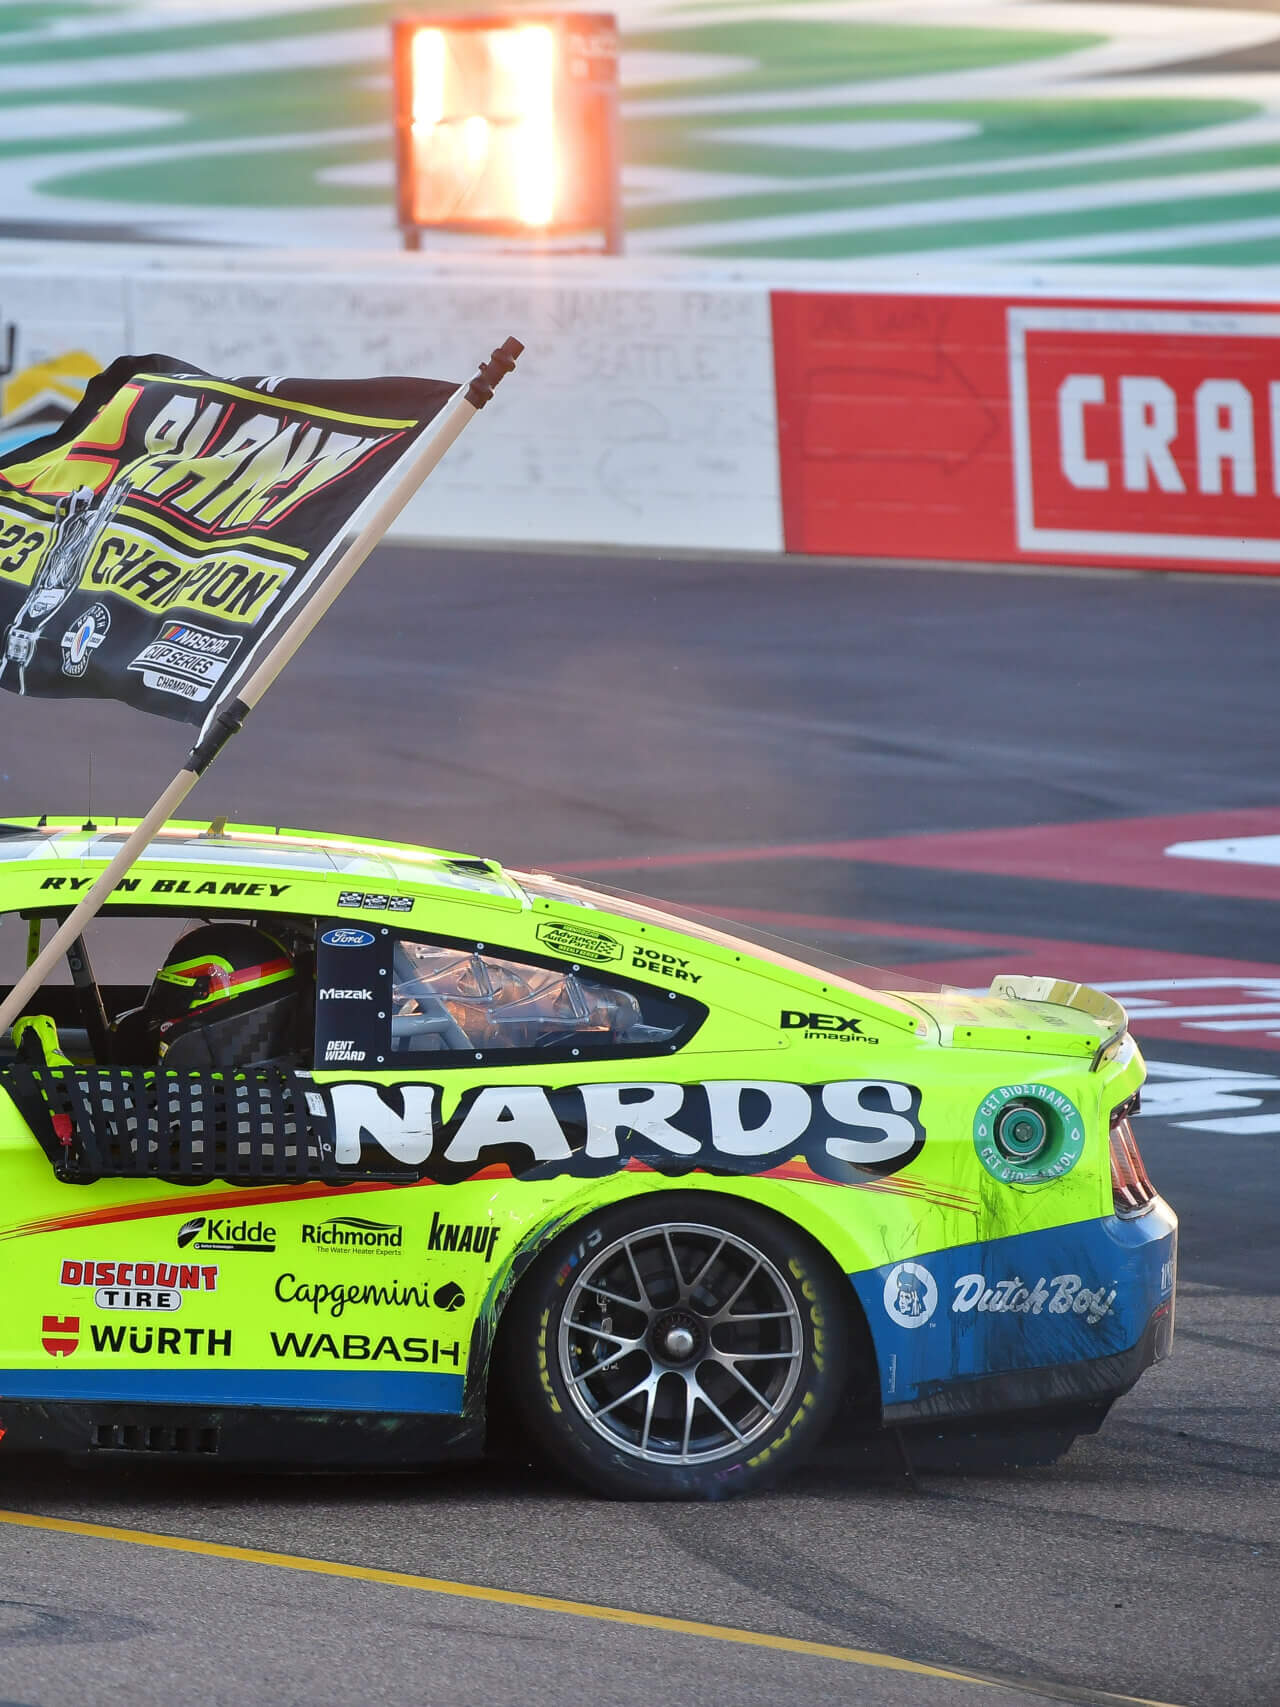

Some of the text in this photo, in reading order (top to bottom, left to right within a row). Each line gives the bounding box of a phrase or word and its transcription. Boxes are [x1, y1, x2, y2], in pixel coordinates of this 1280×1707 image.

[1058, 374, 1280, 498] CRA
[175, 629, 230, 654] NASCAR
[144, 645, 214, 674] CUP SERIES
[156, 675, 199, 697] CHAMPION
[40, 877, 292, 897] RYN BLANEY
[331, 929, 365, 944] Ford
[542, 934, 596, 951] Auto Parts
[551, 929, 598, 946] Advance
[633, 945, 690, 968] JODY
[631, 957, 703, 984] DEERY
[319, 988, 373, 1000] Mazak
[780, 1010, 864, 1034] DEX
[327, 1041, 355, 1051] DENT
[804, 1030, 879, 1045] imaging
[324, 1050, 366, 1061] WIZARD
[981, 1084, 1077, 1121] GET BIOETHANOL
[981, 1147, 1001, 1170] GET
[208, 1219, 276, 1242] Kidde
[302, 1223, 402, 1247] Richmond
[330, 1246, 351, 1254] Water
[352, 1247, 374, 1255] Heater
[376, 1248, 402, 1257] Experts
[60, 1260, 218, 1291] DISCOUNT
[104, 1291, 171, 1308] TIRE
[275, 1273, 431, 1318] Capgemini
[952, 1274, 1046, 1314] Dutch
[1049, 1274, 1118, 1325] Boy
[90, 1325, 232, 1356] WÜRTH
[270, 1332, 460, 1366] WABASH
